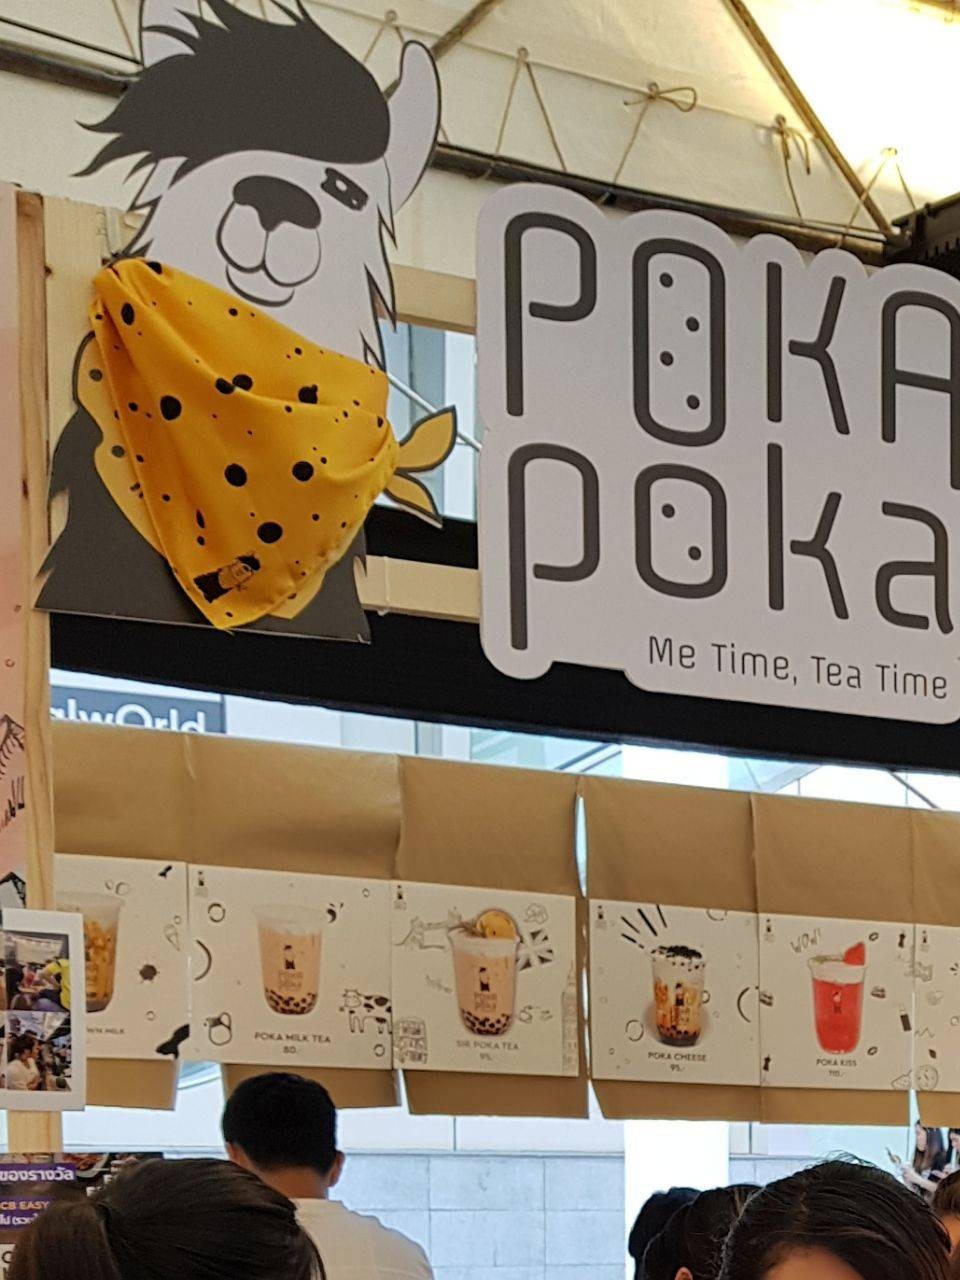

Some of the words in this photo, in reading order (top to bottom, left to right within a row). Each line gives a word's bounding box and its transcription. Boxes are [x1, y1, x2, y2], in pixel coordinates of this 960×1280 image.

[648, 634, 696, 670] Me
[711, 642, 798, 687] Time,
[810, 655, 861, 690] Tea
[875, 664, 947, 699] Time
[255, 1031, 283, 1041] POKA
[312, 1035, 331, 1043] TEA
